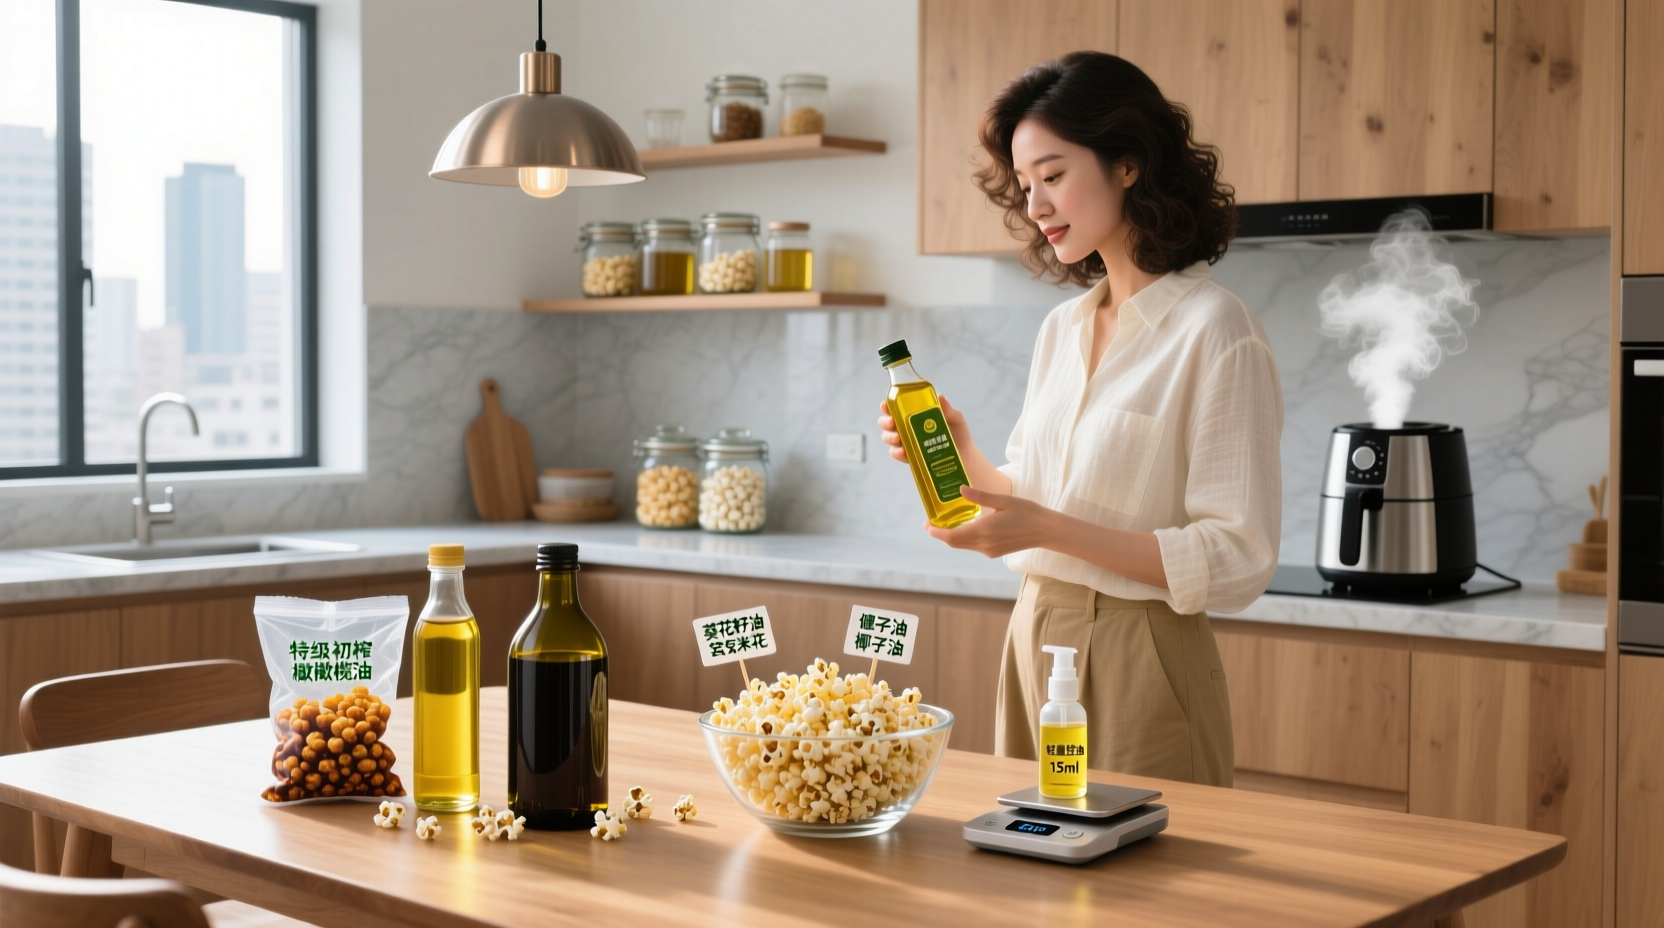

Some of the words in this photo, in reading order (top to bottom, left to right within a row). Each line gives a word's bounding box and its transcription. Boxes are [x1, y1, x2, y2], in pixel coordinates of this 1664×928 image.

[289, 640, 372, 660] 特级初榨
[1050, 760, 1079, 774] 15ml
